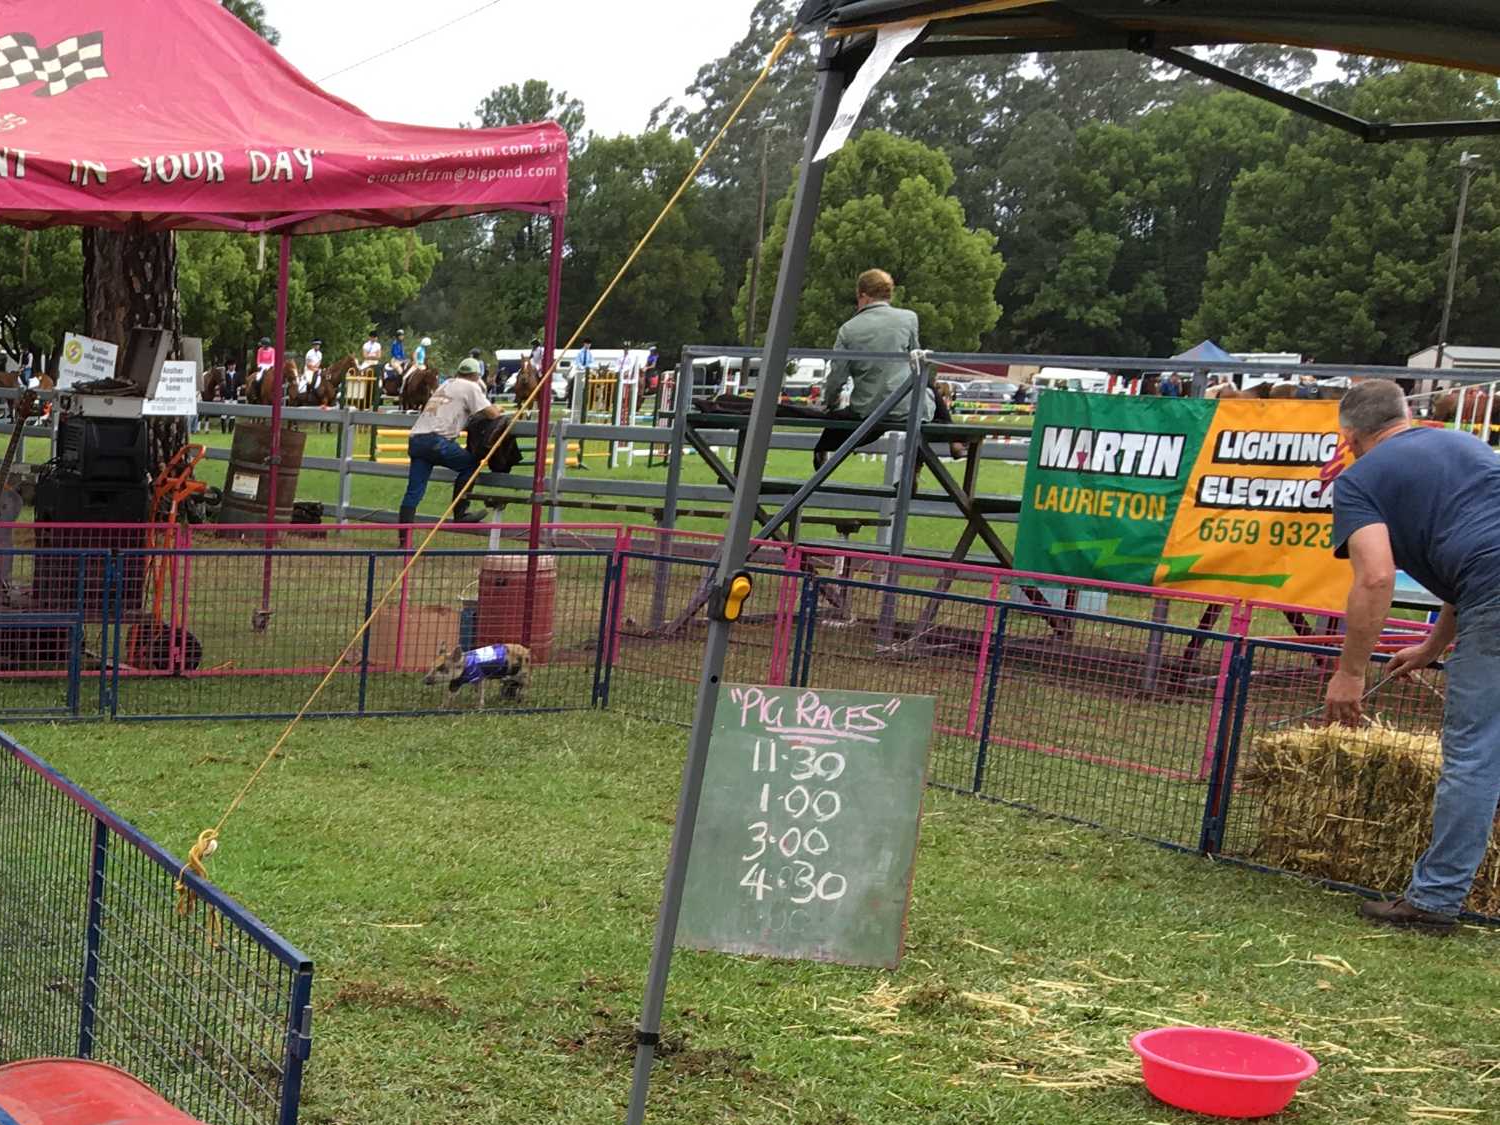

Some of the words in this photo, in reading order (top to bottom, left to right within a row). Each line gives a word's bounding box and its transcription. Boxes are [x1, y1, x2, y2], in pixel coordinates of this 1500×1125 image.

[69, 158, 109, 187] IN
[131, 150, 226, 184] YOUR
[1039, 426, 1185, 479] MARTIN
[1217, 430, 1339, 463] LIGHTING
[1034, 484, 1167, 522] LAURIETON
[1200, 475, 1334, 509] ELECTRICA
[1199, 517, 1261, 546] 6559
[1269, 520, 1334, 549] 9323
